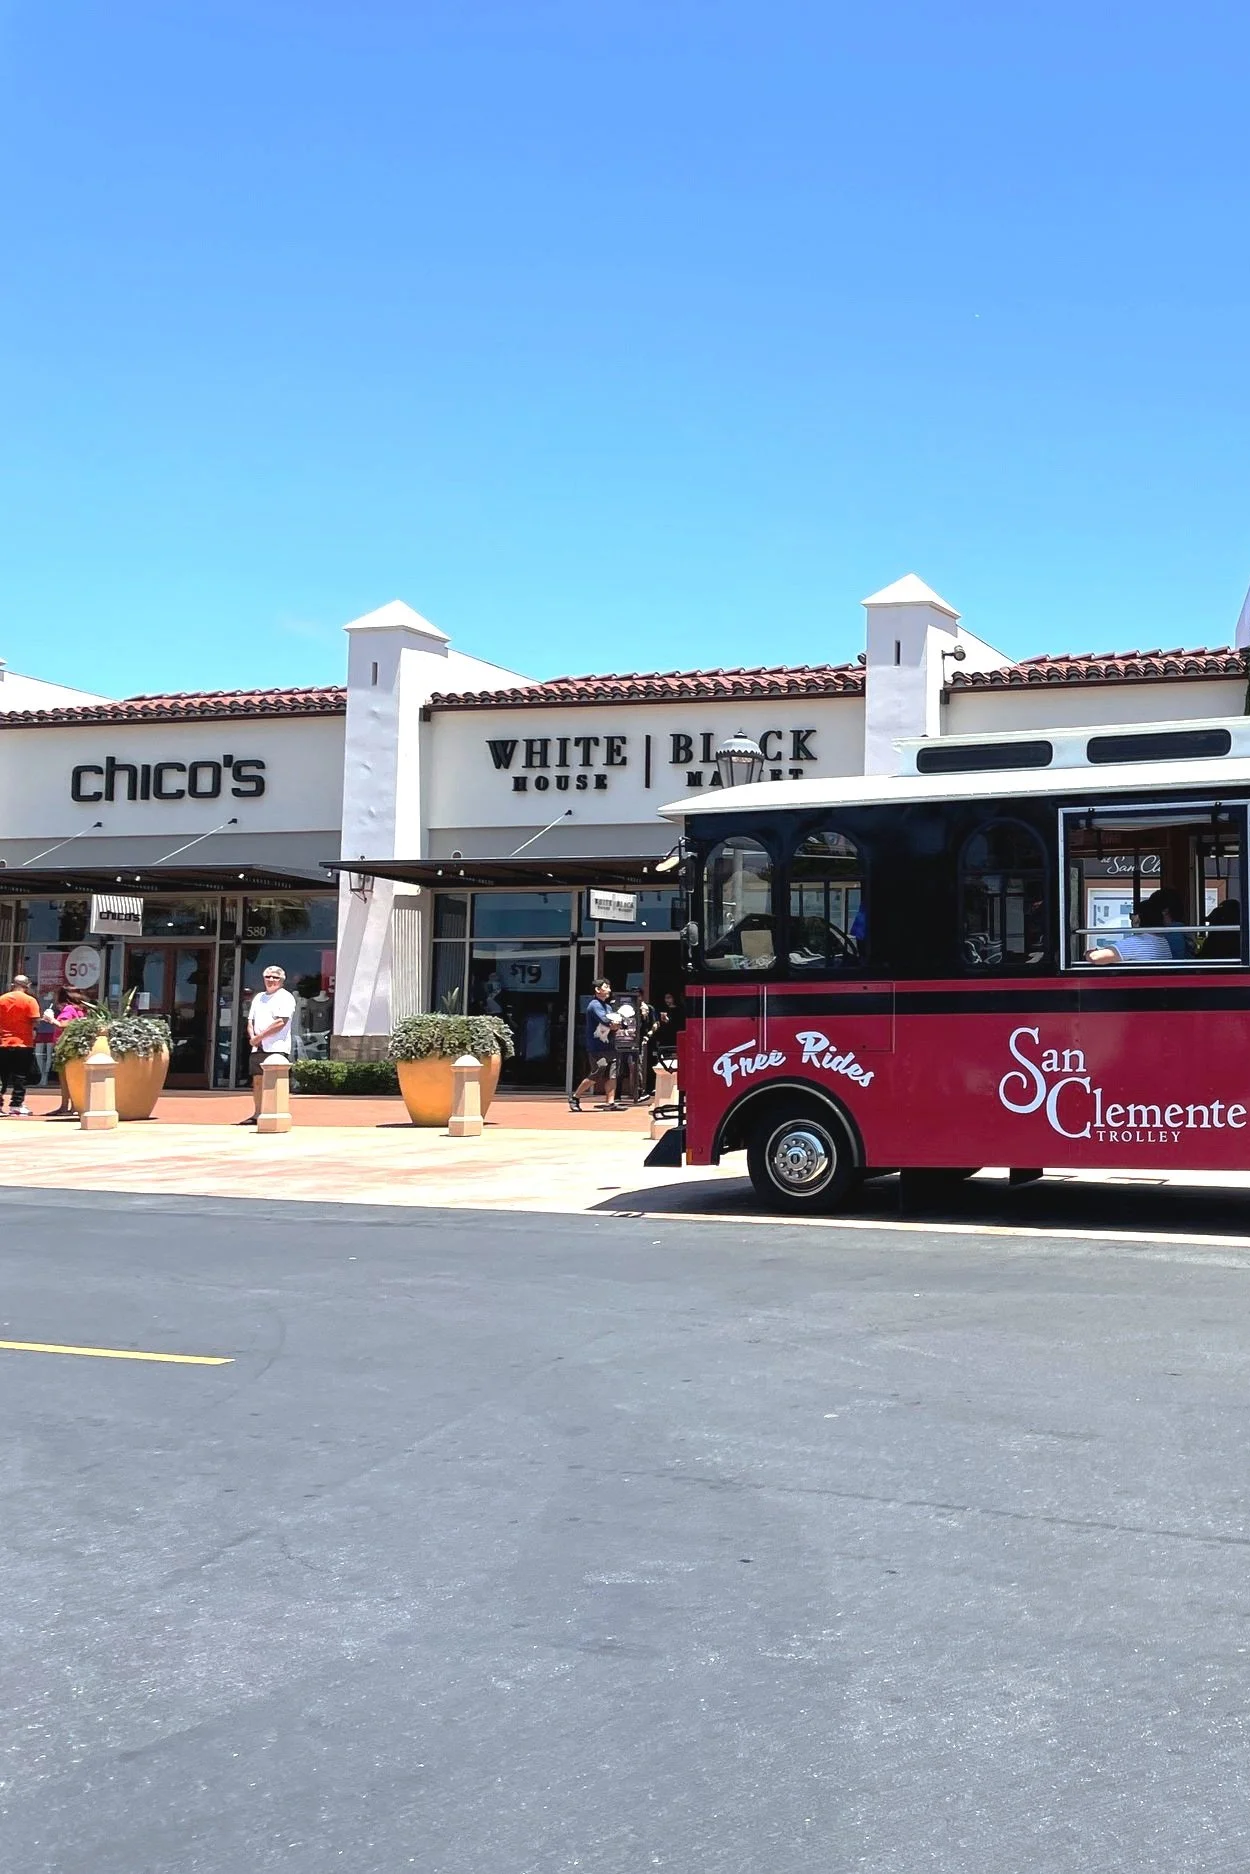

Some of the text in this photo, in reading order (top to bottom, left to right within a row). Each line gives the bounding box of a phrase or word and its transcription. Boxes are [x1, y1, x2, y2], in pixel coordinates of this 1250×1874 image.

[485, 729, 817, 769] WHITE BLCK
[71, 754, 266, 802] chico's
[512, 768, 804, 792] HOUSE MAET
[1140, 855, 1161, 873] Cl
[247, 926, 266, 937] 580
[510, 963, 542, 984] $19
[712, 1030, 875, 1088] Free Rides
[998, 1027, 1087, 1114] San
[1046, 1076, 1247, 1139] Clemente
[1096, 1130, 1181, 1143] TROLLEY
